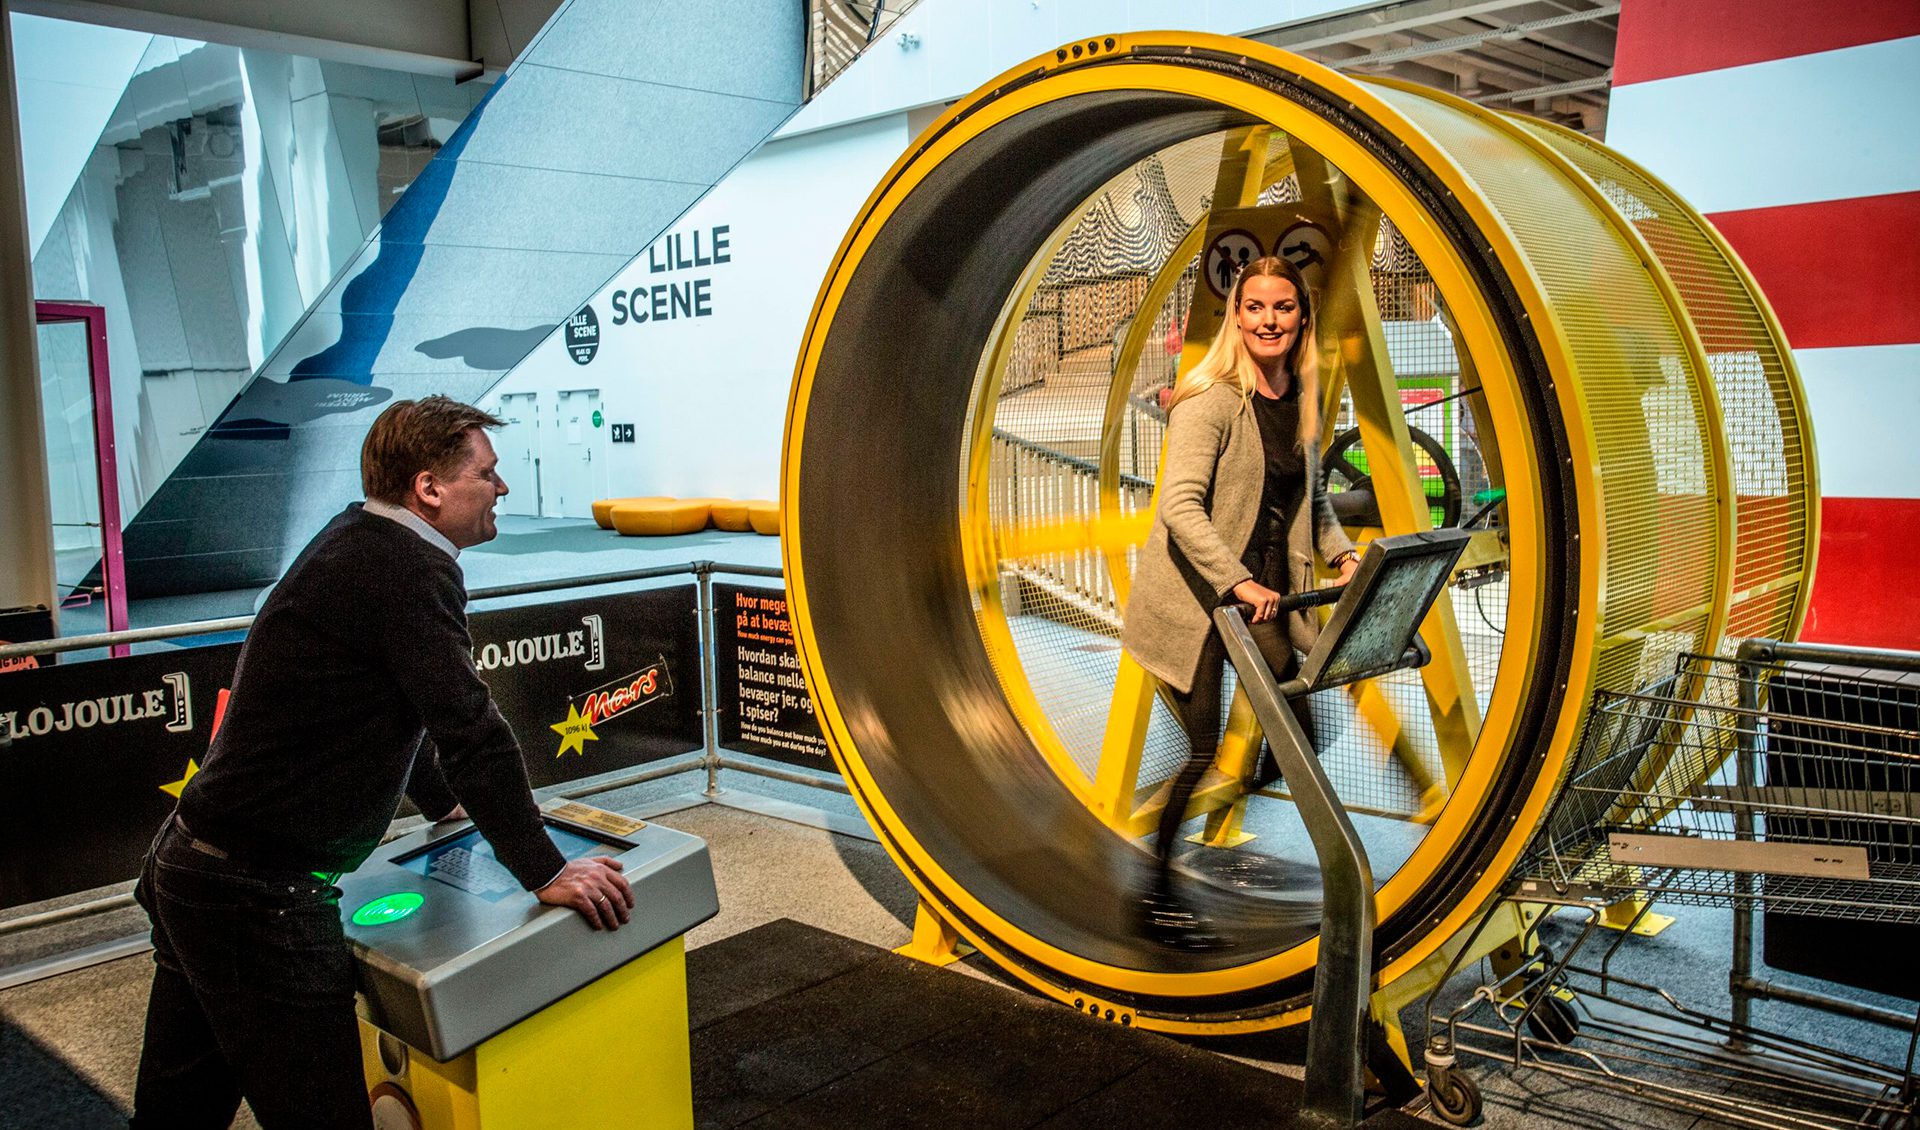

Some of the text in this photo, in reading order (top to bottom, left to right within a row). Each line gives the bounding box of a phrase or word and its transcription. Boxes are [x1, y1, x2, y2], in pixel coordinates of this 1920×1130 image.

[650, 225, 731, 273] LILLE
[612, 278, 712, 325] SCENE
[570, 314, 587, 327] LILLE
[574, 325, 597, 338] SCENE
[736, 592, 786, 616] Hvor mege
[736, 610, 749, 629] på
[750, 614, 760, 629] at
[737, 630, 747, 638] How
[748, 632, 759, 640] much
[738, 645, 777, 666] Hvordan
[738, 664, 807, 690] balance melle
[581, 668, 658, 725] Mars
[739, 682, 813, 714] bevæger jer, og
[740, 701, 779, 723] I spiser?
[565, 724, 581, 735] 1096
[740, 721, 751, 730] How
[751, 723, 757, 732] do
[758, 726, 766, 734] you
[766, 726, 784, 737] balance
[784, 731, 792, 739] out
[793, 732, 803, 741] how
[804, 735, 817, 744] much
[741, 732, 750, 740] and
[750, 733, 759, 742] how
[760, 737, 772, 745] much
[790, 741, 805, 754] during
[806, 745, 814, 754] the
[814, 746, 826, 758] day?
